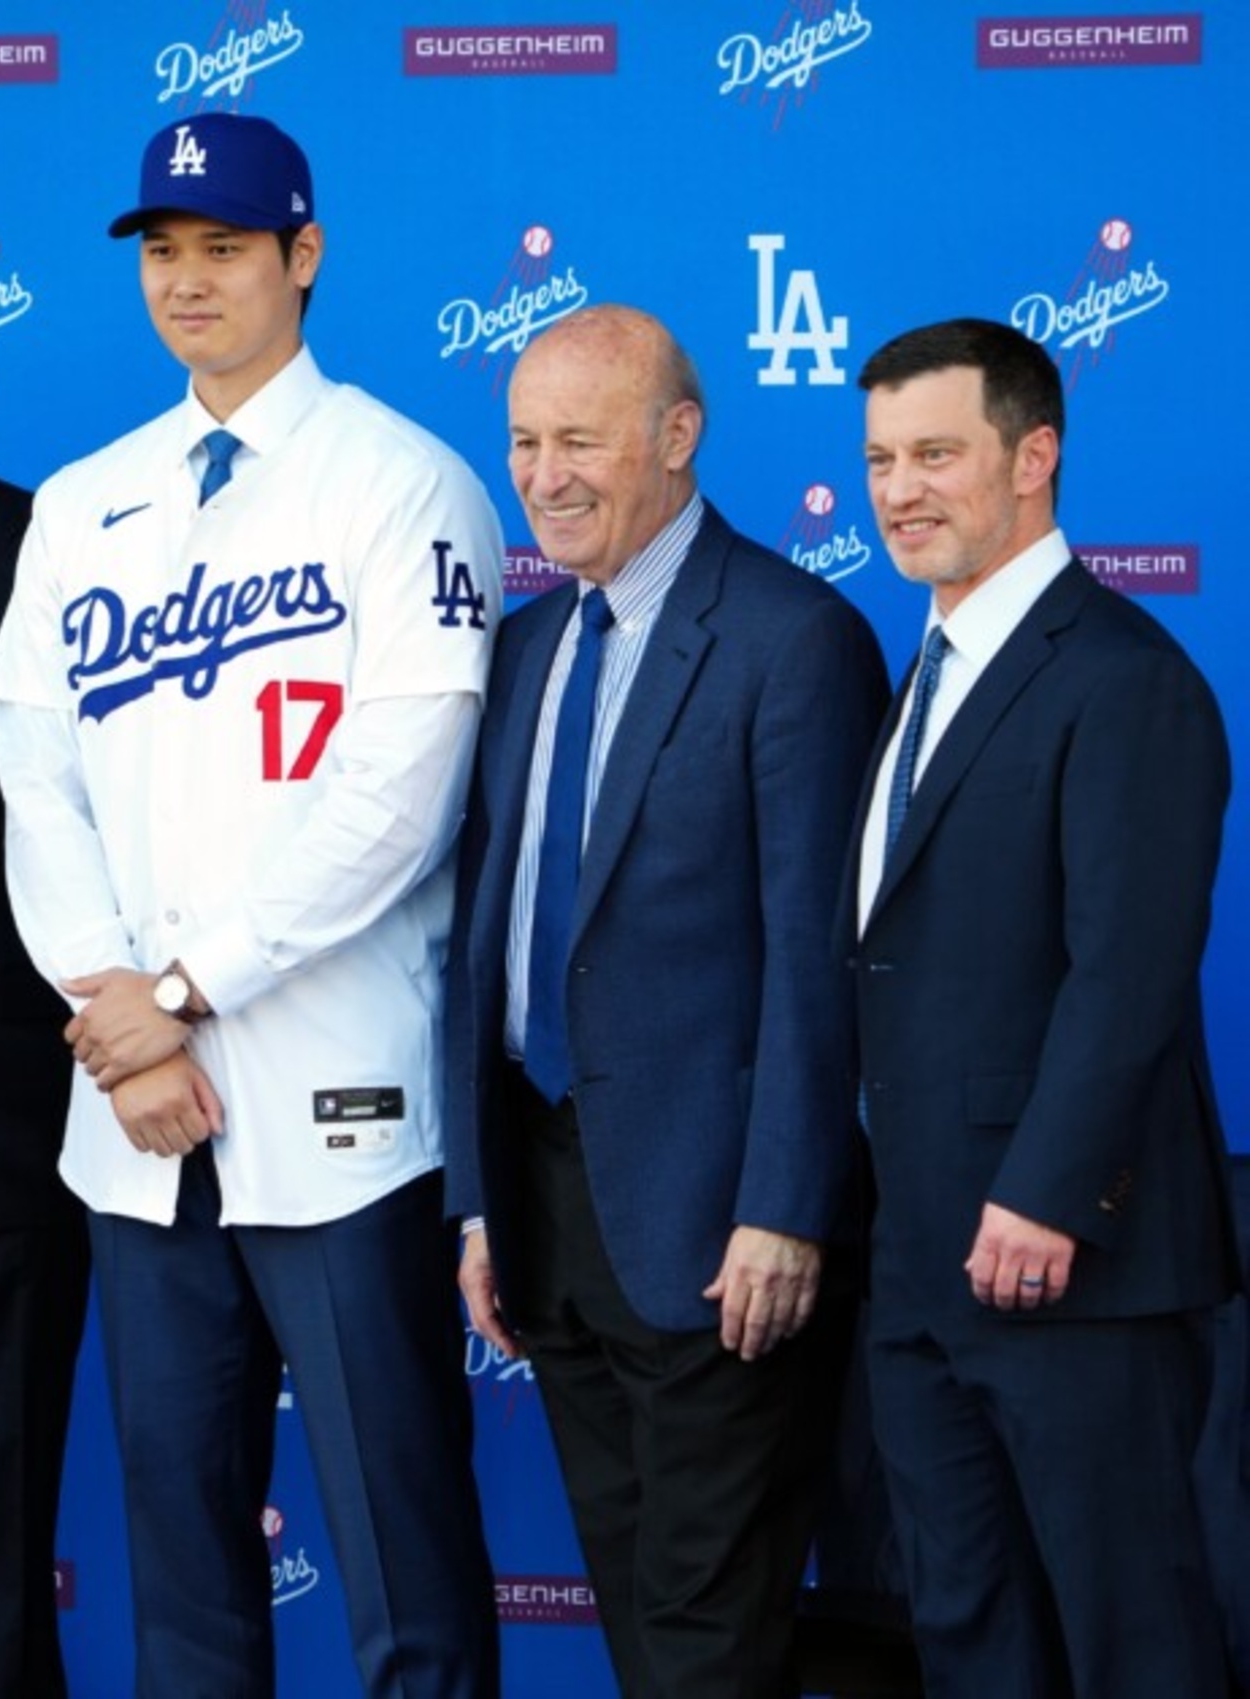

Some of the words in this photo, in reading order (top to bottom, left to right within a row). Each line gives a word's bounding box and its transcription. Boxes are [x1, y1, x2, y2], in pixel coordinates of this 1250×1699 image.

[155, 10, 303, 103] Dodgers
[416, 33, 604, 56] GUGGENHEIM
[471, 58, 545, 70] BASEBALL
[717, 1, 871, 95] Dodgers
[989, 24, 1189, 48] GUGGENHEIM
[1048, 49, 1126, 61] BASEBALL
[170, 126, 206, 176] LA
[438, 267, 587, 358] Dodgers
[748, 234, 848, 386] LA
[1010, 260, 1169, 349] Dodgers
[432, 541, 485, 631] LA
[62, 562, 347, 725] Dodgers
[256, 678, 343, 782] 17
